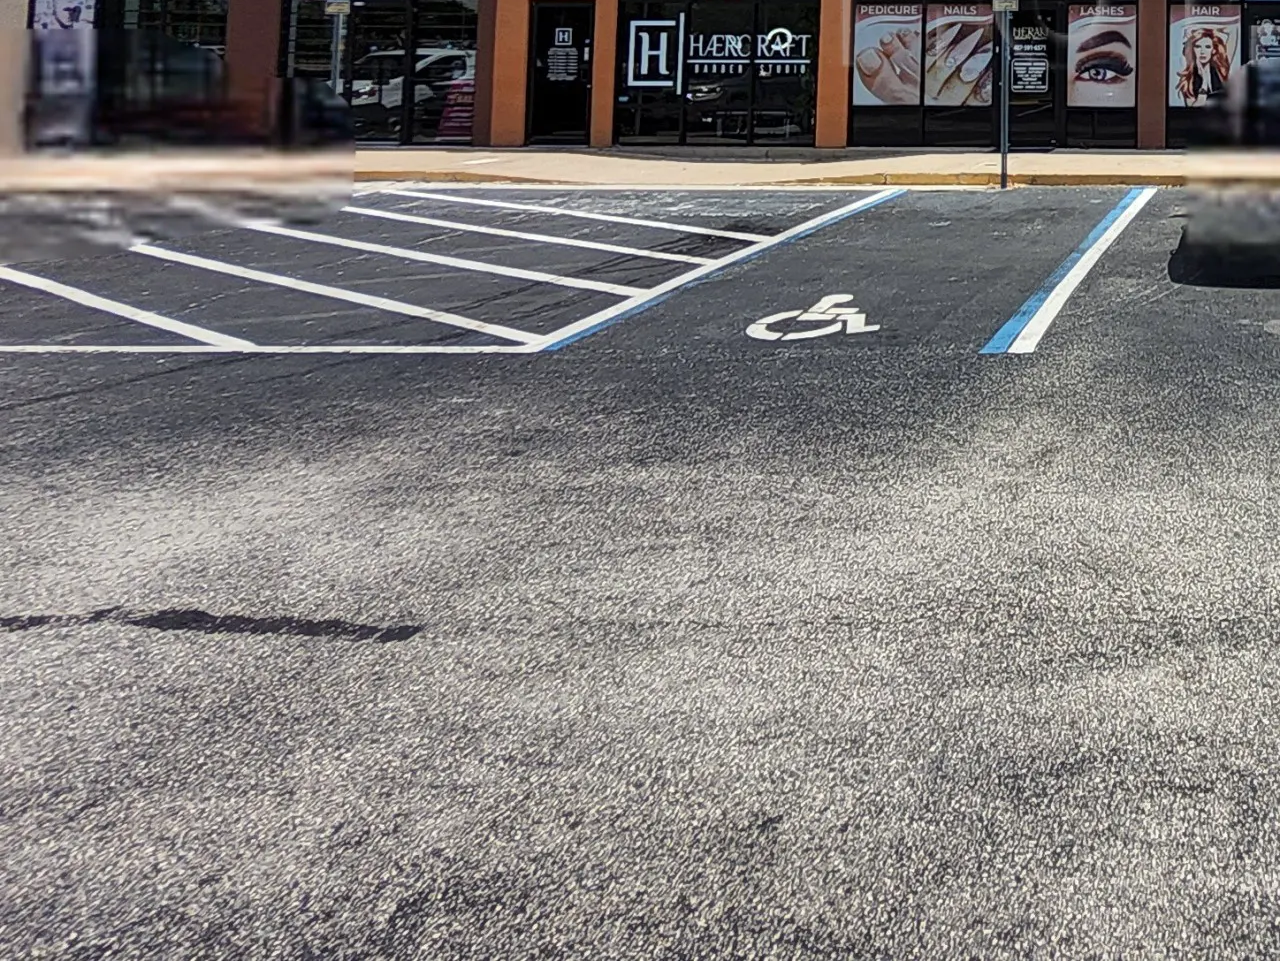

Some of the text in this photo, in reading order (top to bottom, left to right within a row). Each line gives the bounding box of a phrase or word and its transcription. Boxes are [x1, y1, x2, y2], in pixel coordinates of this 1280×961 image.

[860, 5, 918, 16] PEDICURE
[944, 5, 977, 16] NAILS
[1079, 5, 1124, 16] LASHES
[1191, 5, 1221, 16] HAIR
